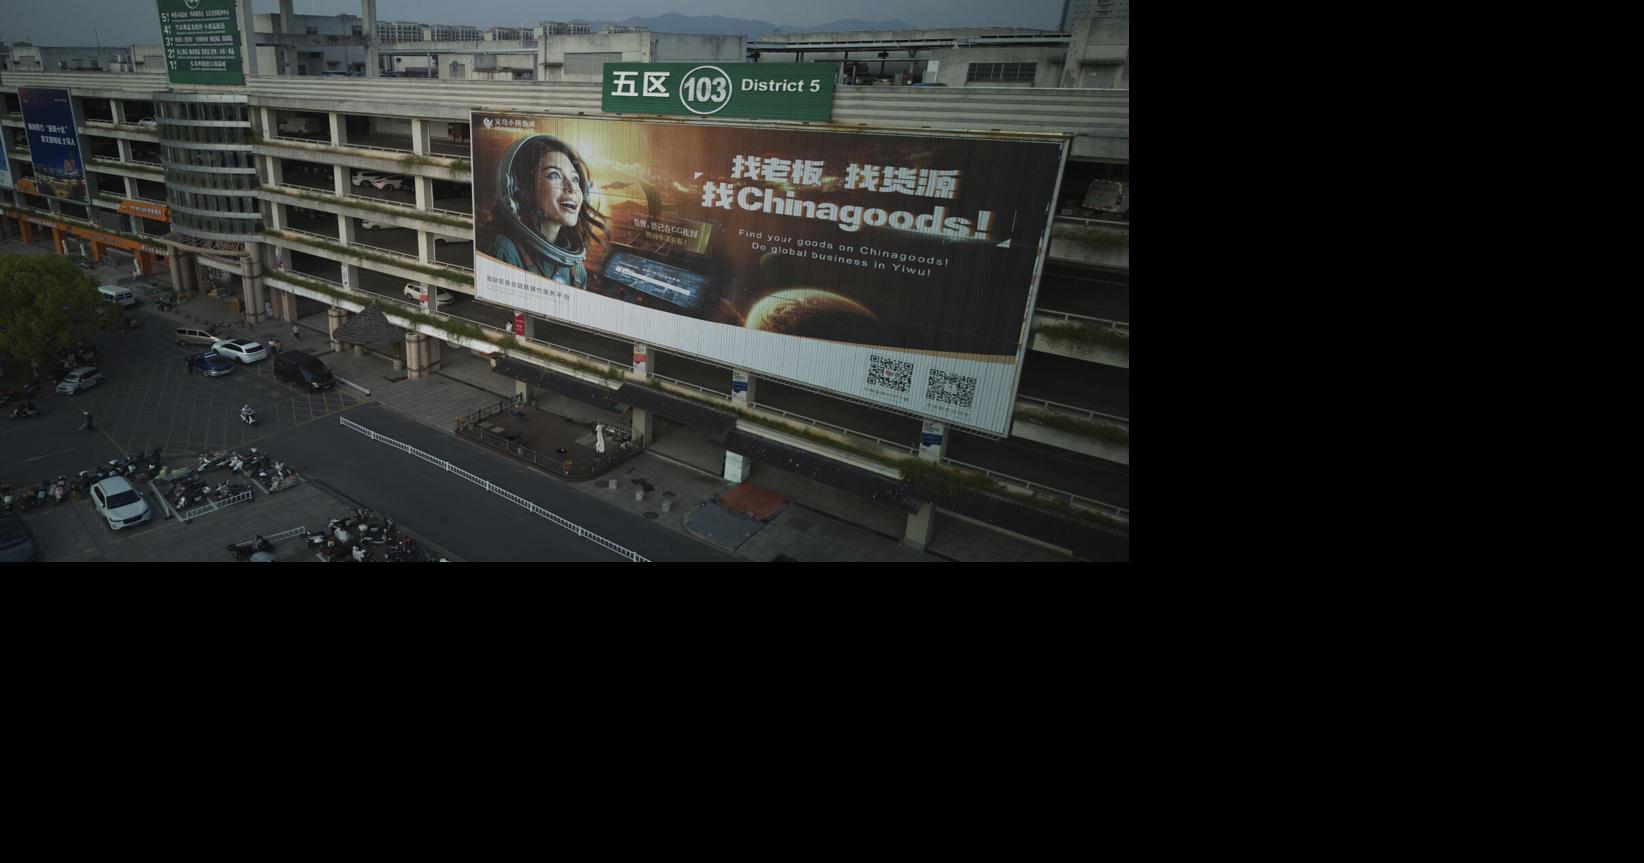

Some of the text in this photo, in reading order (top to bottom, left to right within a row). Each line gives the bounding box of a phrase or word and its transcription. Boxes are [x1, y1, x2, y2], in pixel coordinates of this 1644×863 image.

[611, 70, 820, 103] 五区 103 District 5
[731, 154, 962, 199] 找老板 找货源
[738, 229, 763, 239] Find
[767, 233, 792, 244] your
[797, 237, 834, 250] goods
[859, 246, 949, 267] Chinagoods!
[751, 242, 931, 277] Do global business in Yiwu!
